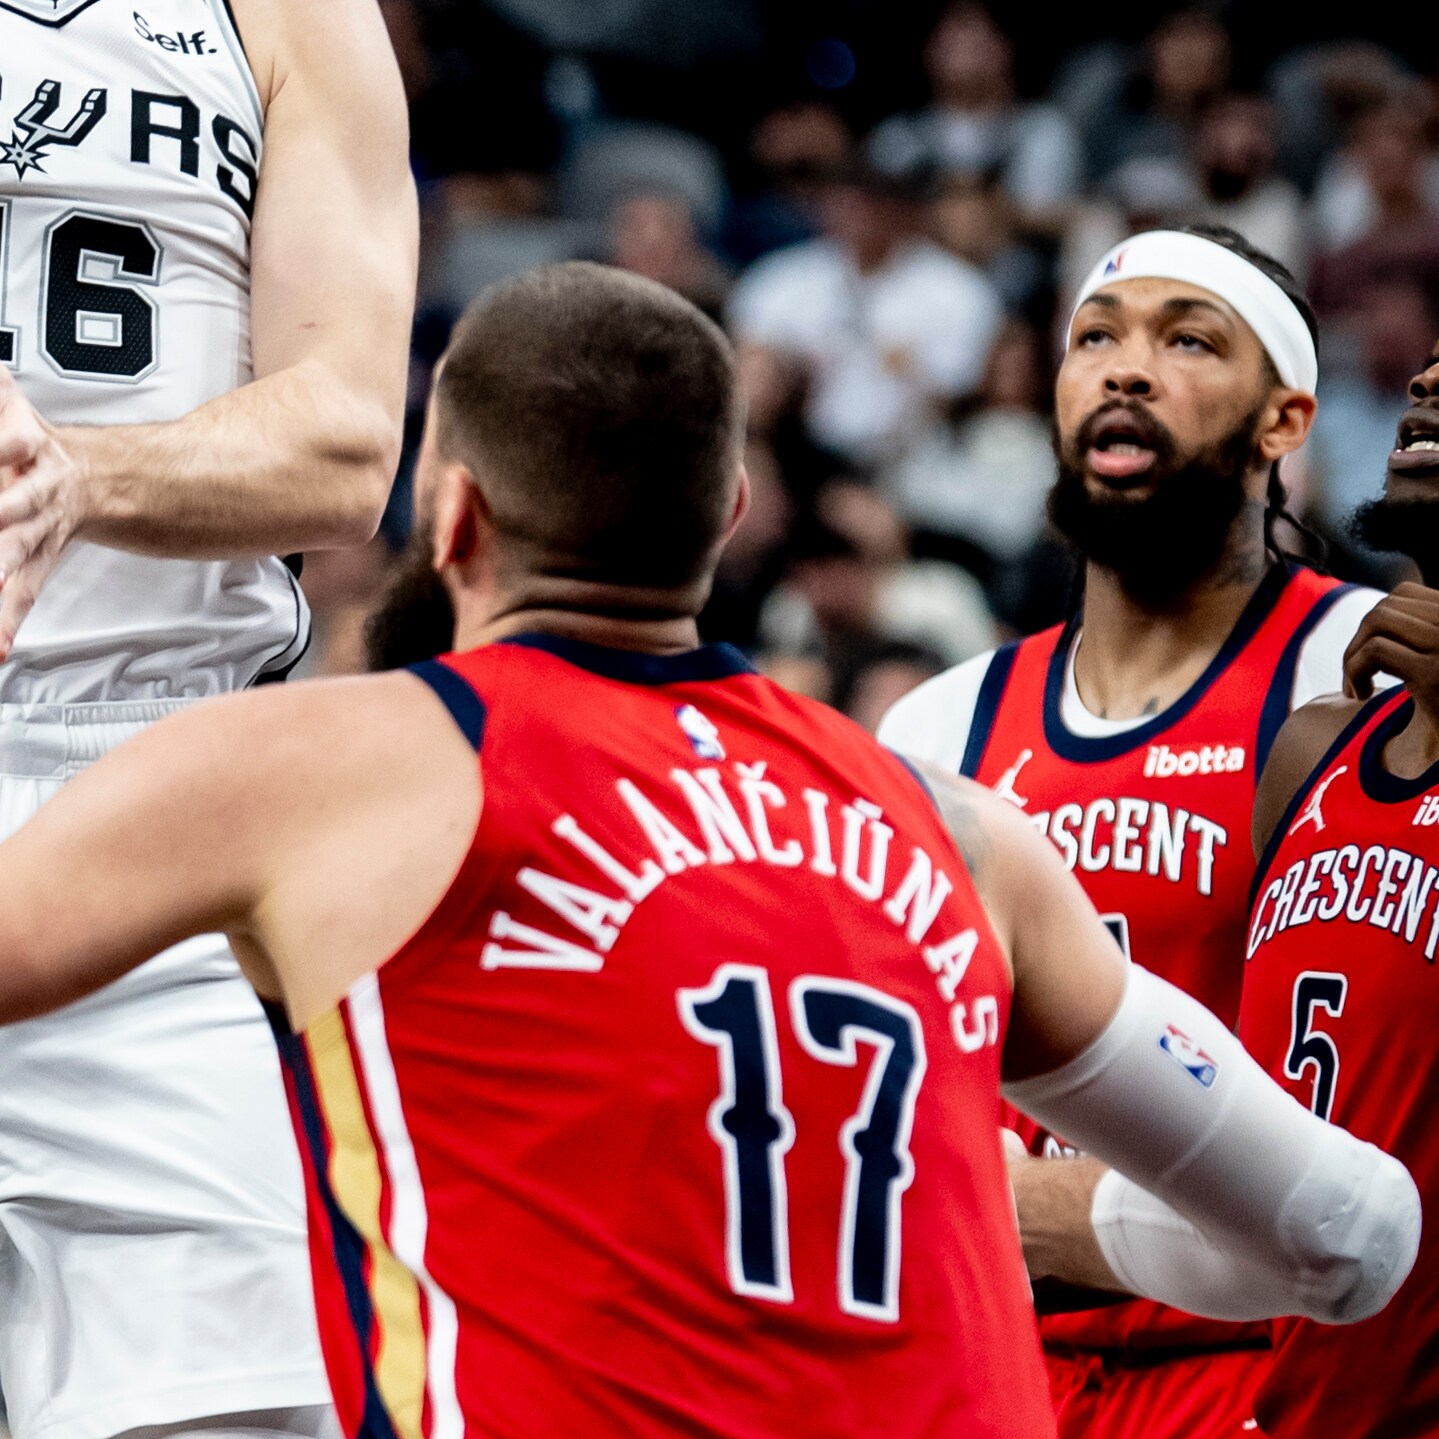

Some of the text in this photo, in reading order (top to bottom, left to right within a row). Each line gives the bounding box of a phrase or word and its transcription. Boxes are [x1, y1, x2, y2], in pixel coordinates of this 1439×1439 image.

[132, 10, 218, 55] Self.
[1143, 745, 1246, 778] ibotta
[480, 760, 1000, 1053] VALANČIŪNAS
[1029, 796, 1228, 896] SCENT
[1284, 970, 1349, 1121] 5
[676, 962, 927, 1323] 17
